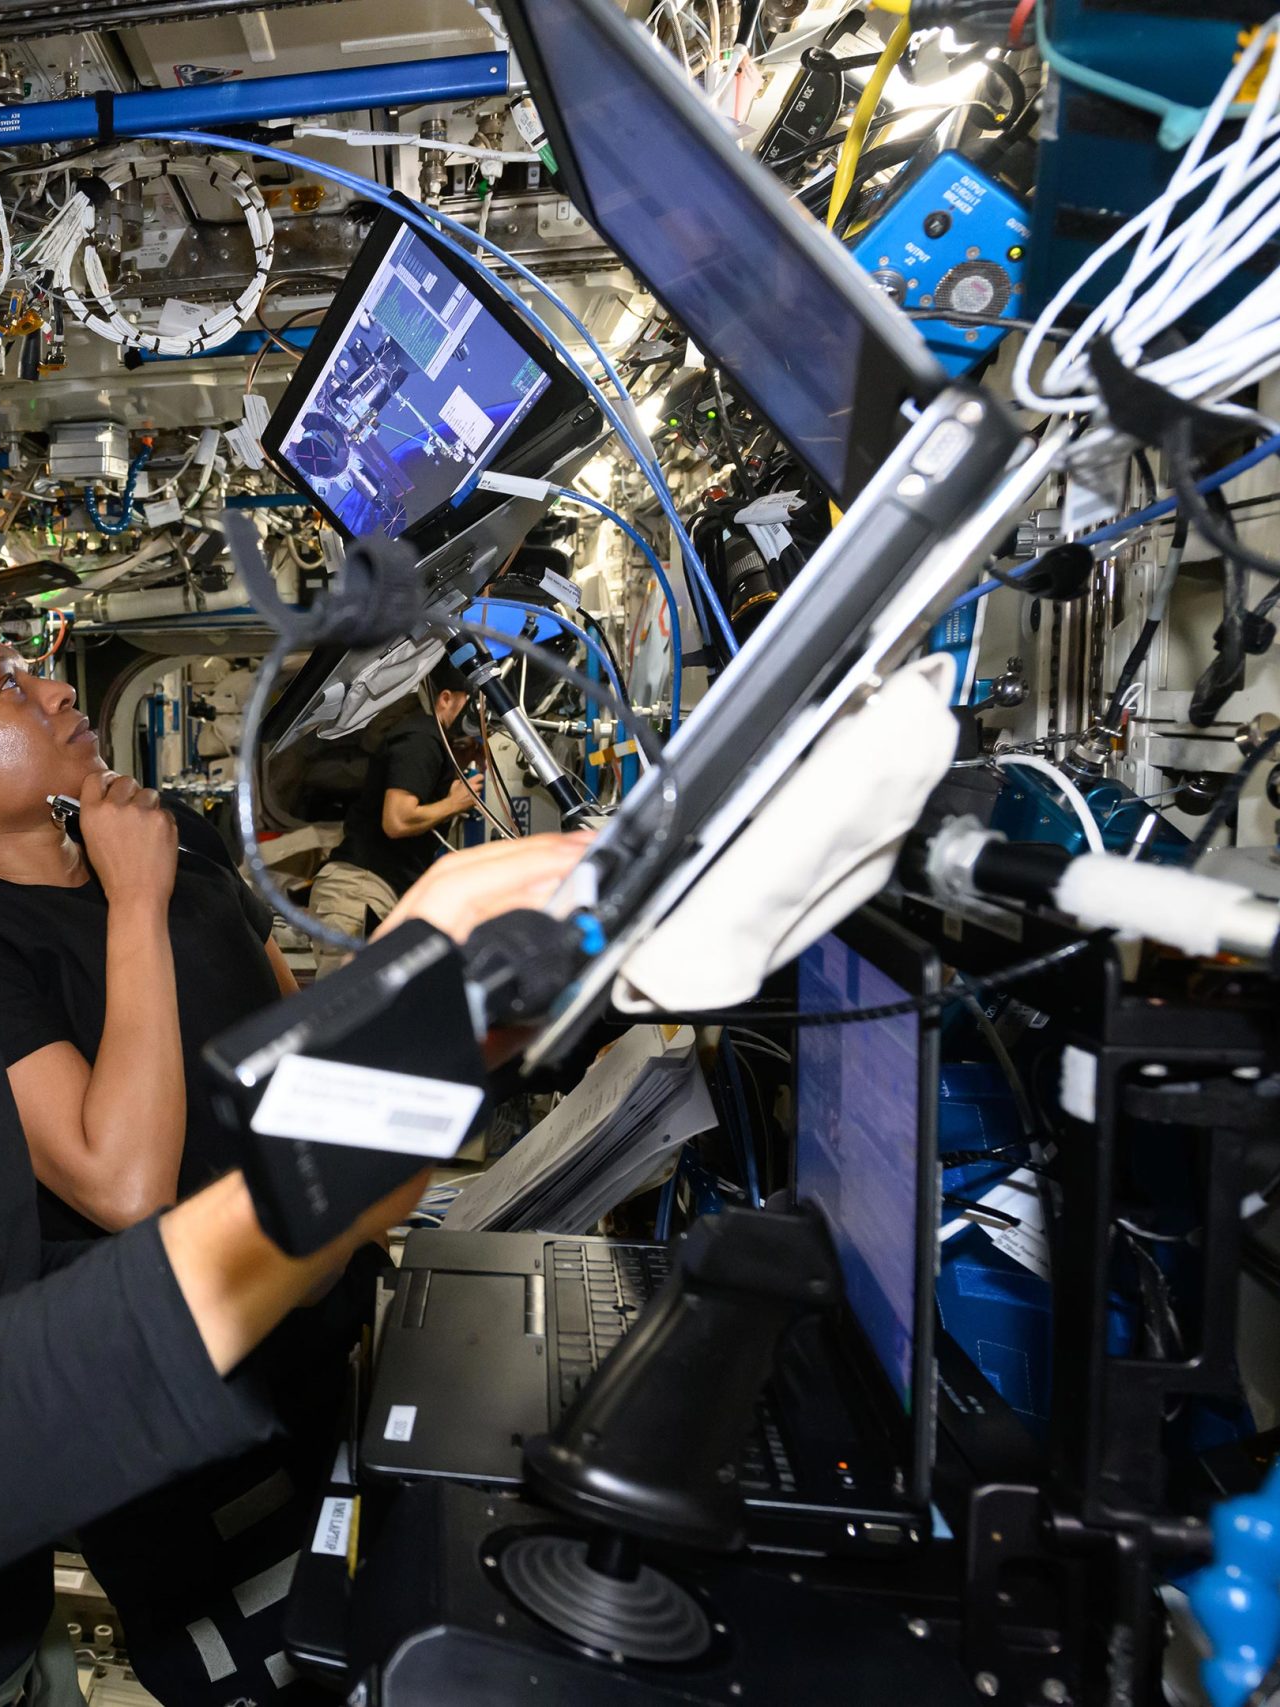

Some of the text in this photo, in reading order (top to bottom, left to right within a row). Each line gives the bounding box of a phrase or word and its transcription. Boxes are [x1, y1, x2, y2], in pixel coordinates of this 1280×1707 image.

[794, 85, 815, 113] 120 VDC
[807, 124, 818, 135] ON
[950, 182, 982, 207] CIRCUIT
[960, 175, 988, 197] OUTPUT
[942, 190, 974, 216] BREAKER
[904, 241, 932, 264] OUTPUT
[512, 800, 529, 837] ST
[323, 1519, 344, 1552] LAPTOP
